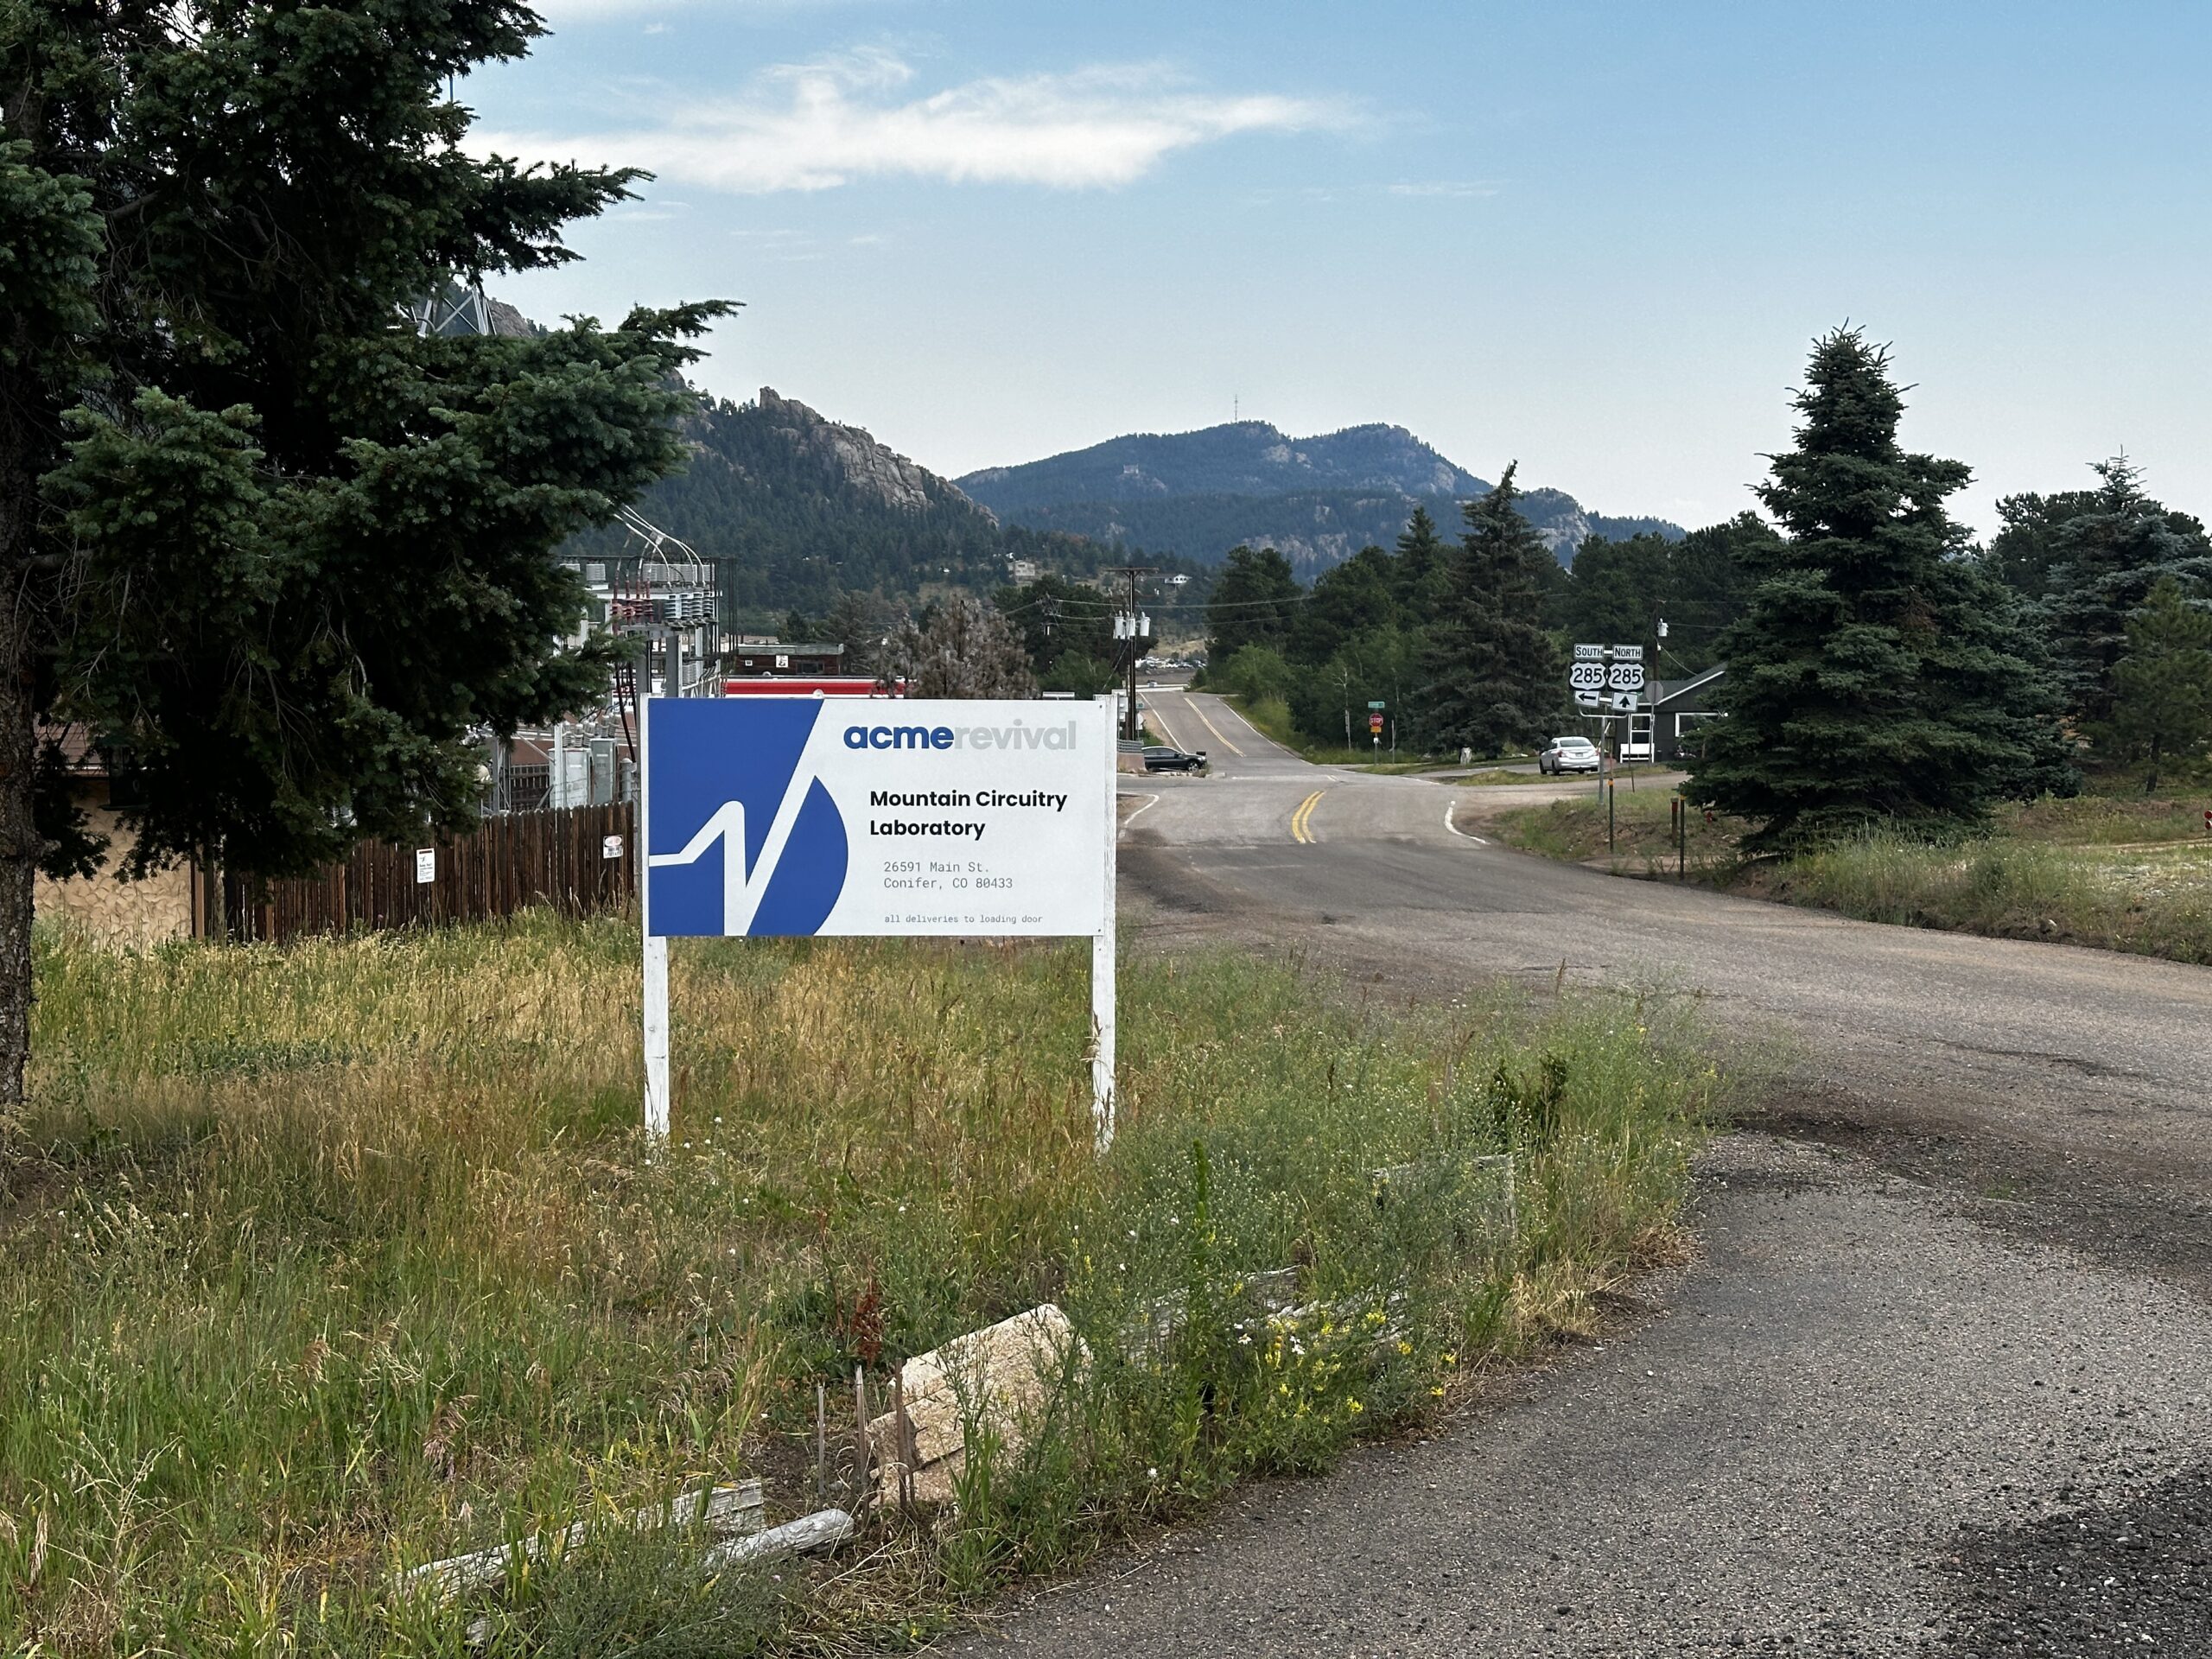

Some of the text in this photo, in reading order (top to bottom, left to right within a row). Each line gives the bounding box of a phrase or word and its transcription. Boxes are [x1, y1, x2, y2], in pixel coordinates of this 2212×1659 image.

[1576, 646, 1602, 656] SOUTH
[1615, 647, 1640, 657] NORTH
[1573, 667, 1602, 683] 285
[1611, 668, 1641, 684] 285
[843, 719, 1077, 750] acmerevival
[870, 789, 1068, 812] Mountain Circuitry
[870, 819, 986, 841] Laboratory
[884, 861, 989, 873] 26591 Main St.
[884, 877, 1013, 890] Conifer, CO 80433
[884, 914, 1043, 925] all deliveries to loading door
